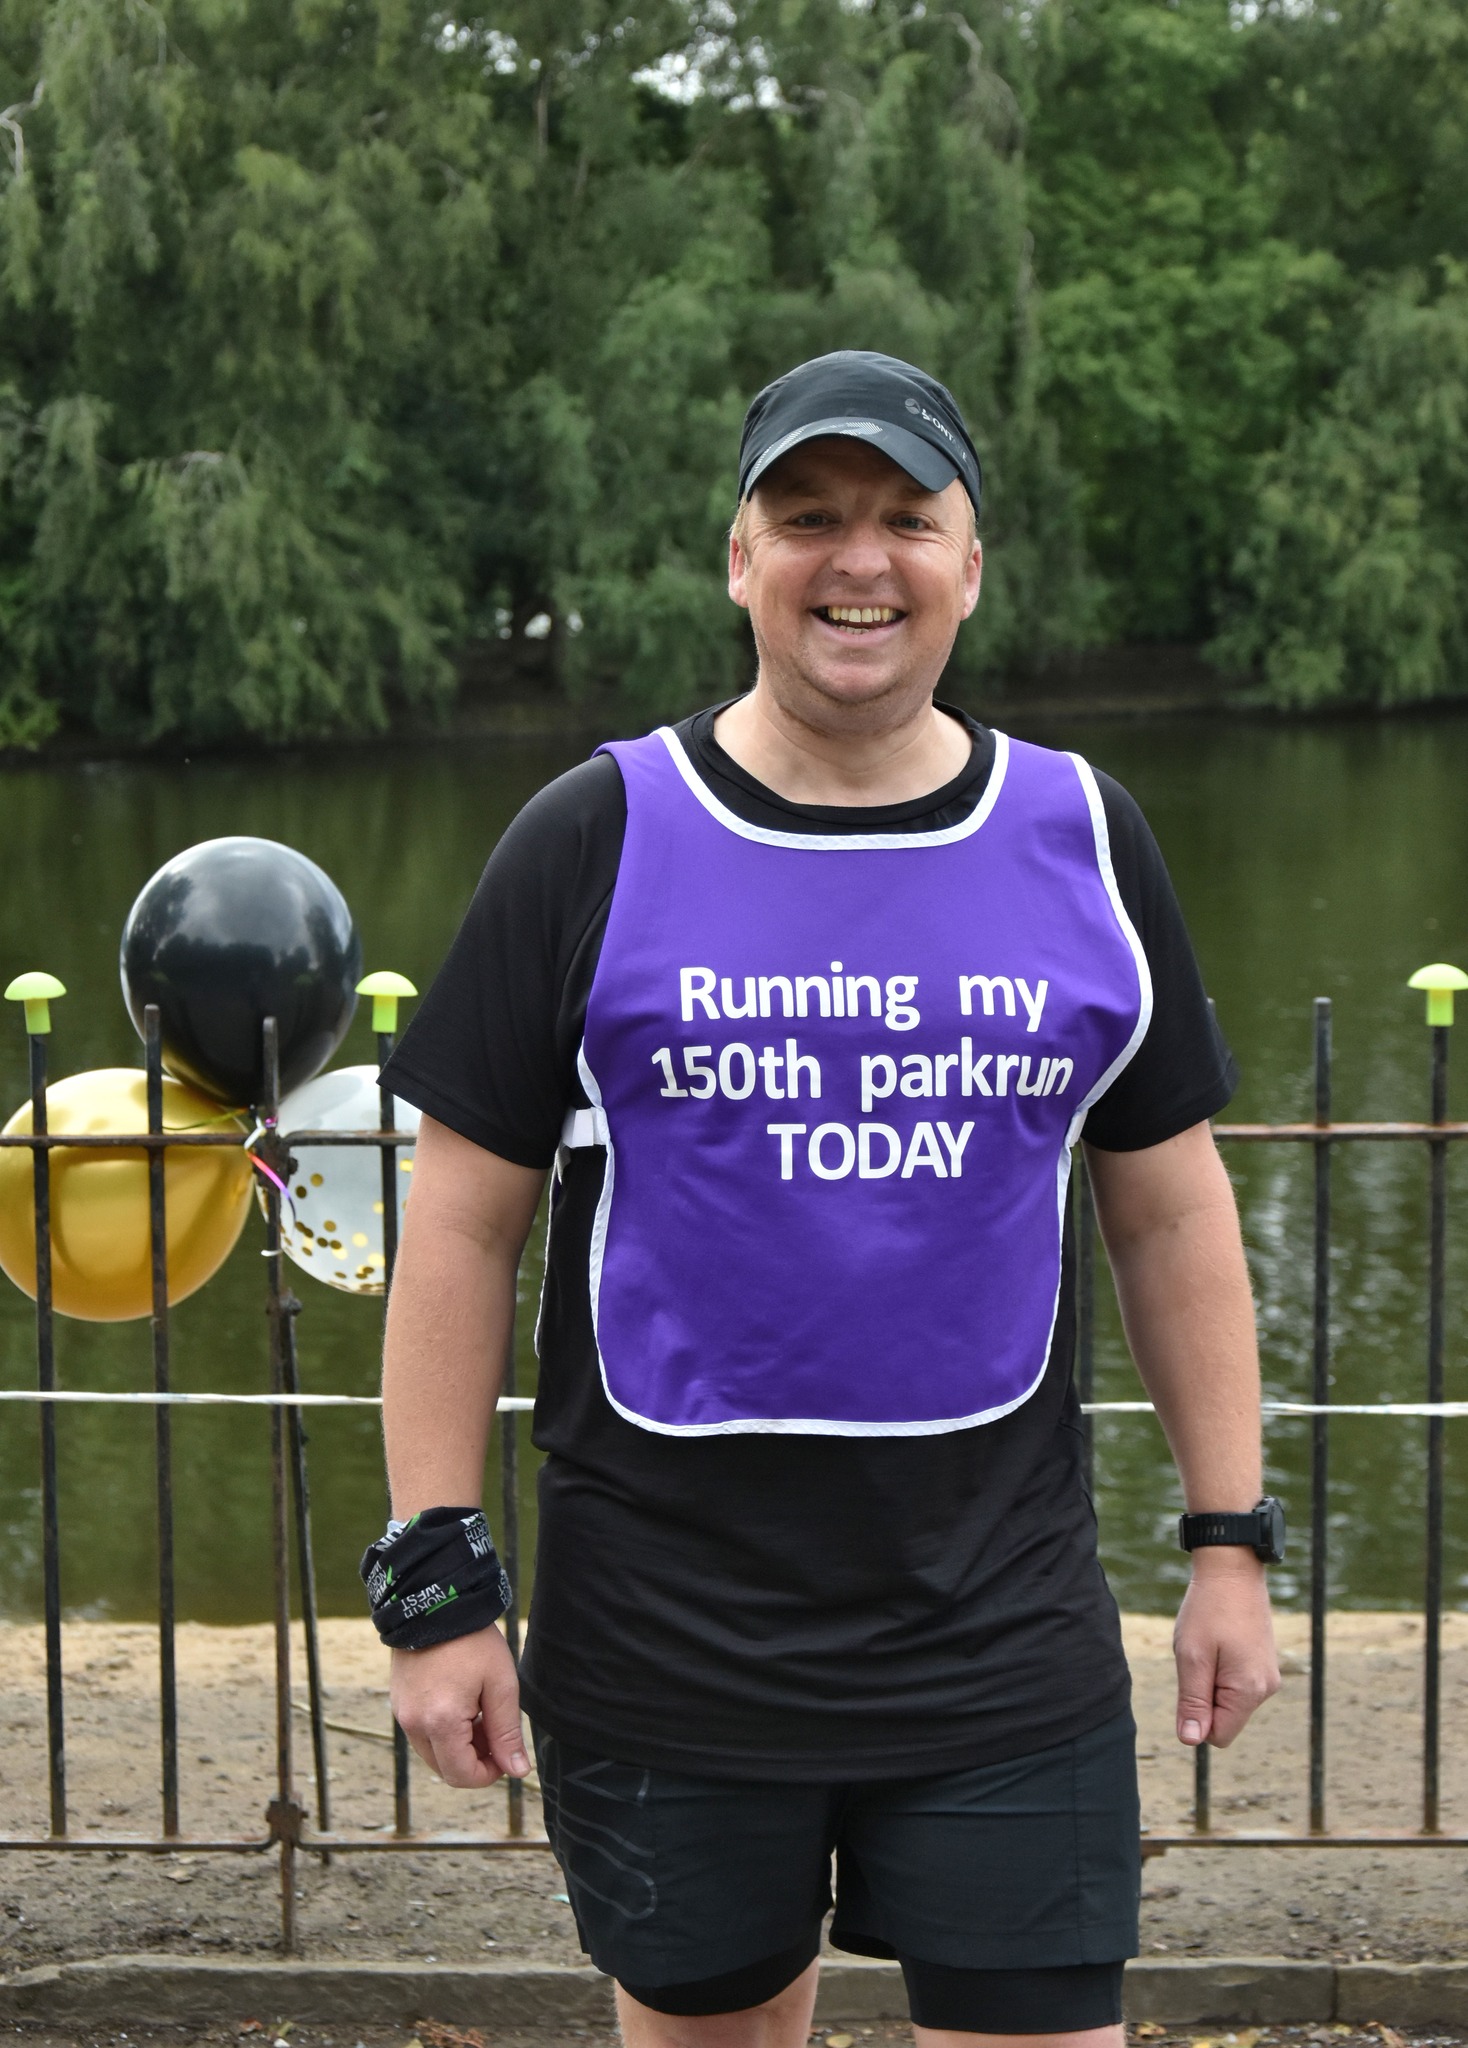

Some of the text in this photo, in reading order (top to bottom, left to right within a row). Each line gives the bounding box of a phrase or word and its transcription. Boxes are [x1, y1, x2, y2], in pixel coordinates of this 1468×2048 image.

[680, 961, 1048, 1032] Running my
[652, 1037, 1073, 1112] 150th parkrun
[767, 1121, 975, 1180] TODAY
